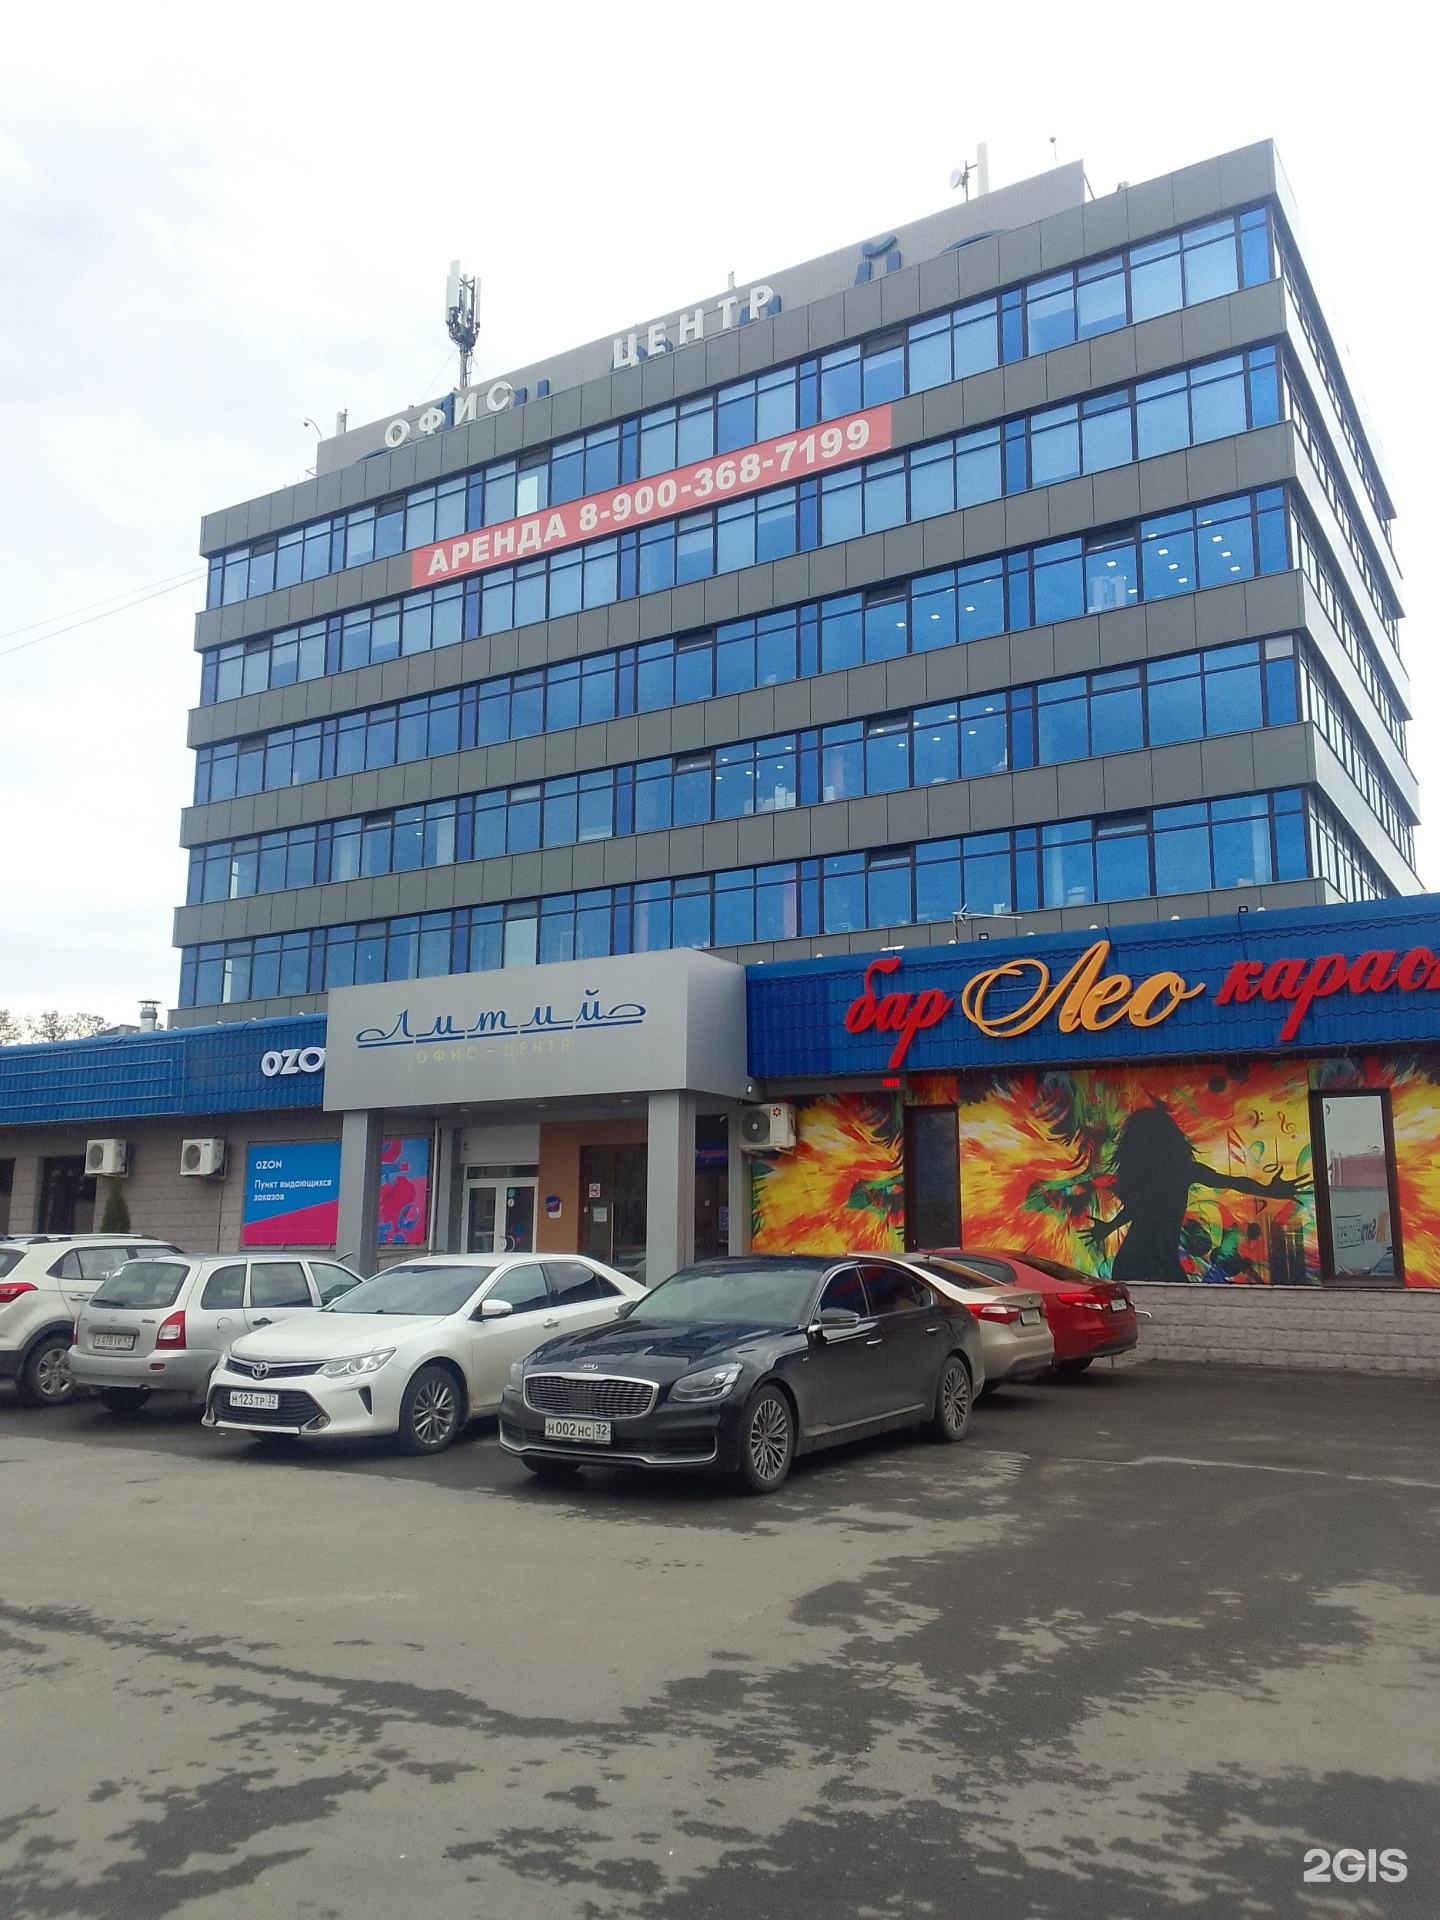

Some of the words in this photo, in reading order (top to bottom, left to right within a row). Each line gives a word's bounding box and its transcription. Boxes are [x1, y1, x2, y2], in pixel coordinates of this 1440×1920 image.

[385, 381, 513, 448] ОФИС
[613, 285, 774, 369] ЦЕНТР
[427, 513, 566, 576] АРЕНДА
[578, 419, 870, 531] 8-900-368-7199
[845, 956, 955, 1069] бар
[961, 939, 1206, 1038] Лео
[1215, 946, 1440, 1041] карао
[355, 988, 646, 1044] Литий
[261, 1046, 327, 1077] OZO
[255, 1159, 283, 1170] OZON
[254, 1179, 278, 1190] Пункт
[279, 1179, 332, 1189] выдающихся
[253, 1193, 285, 1202] заказов
[231, 1393, 265, 1406] М123ТР
[267, 1394, 276, 1404] 32
[548, 1421, 592, 1437] Н002НС
[595, 1423, 607, 1435] 32
